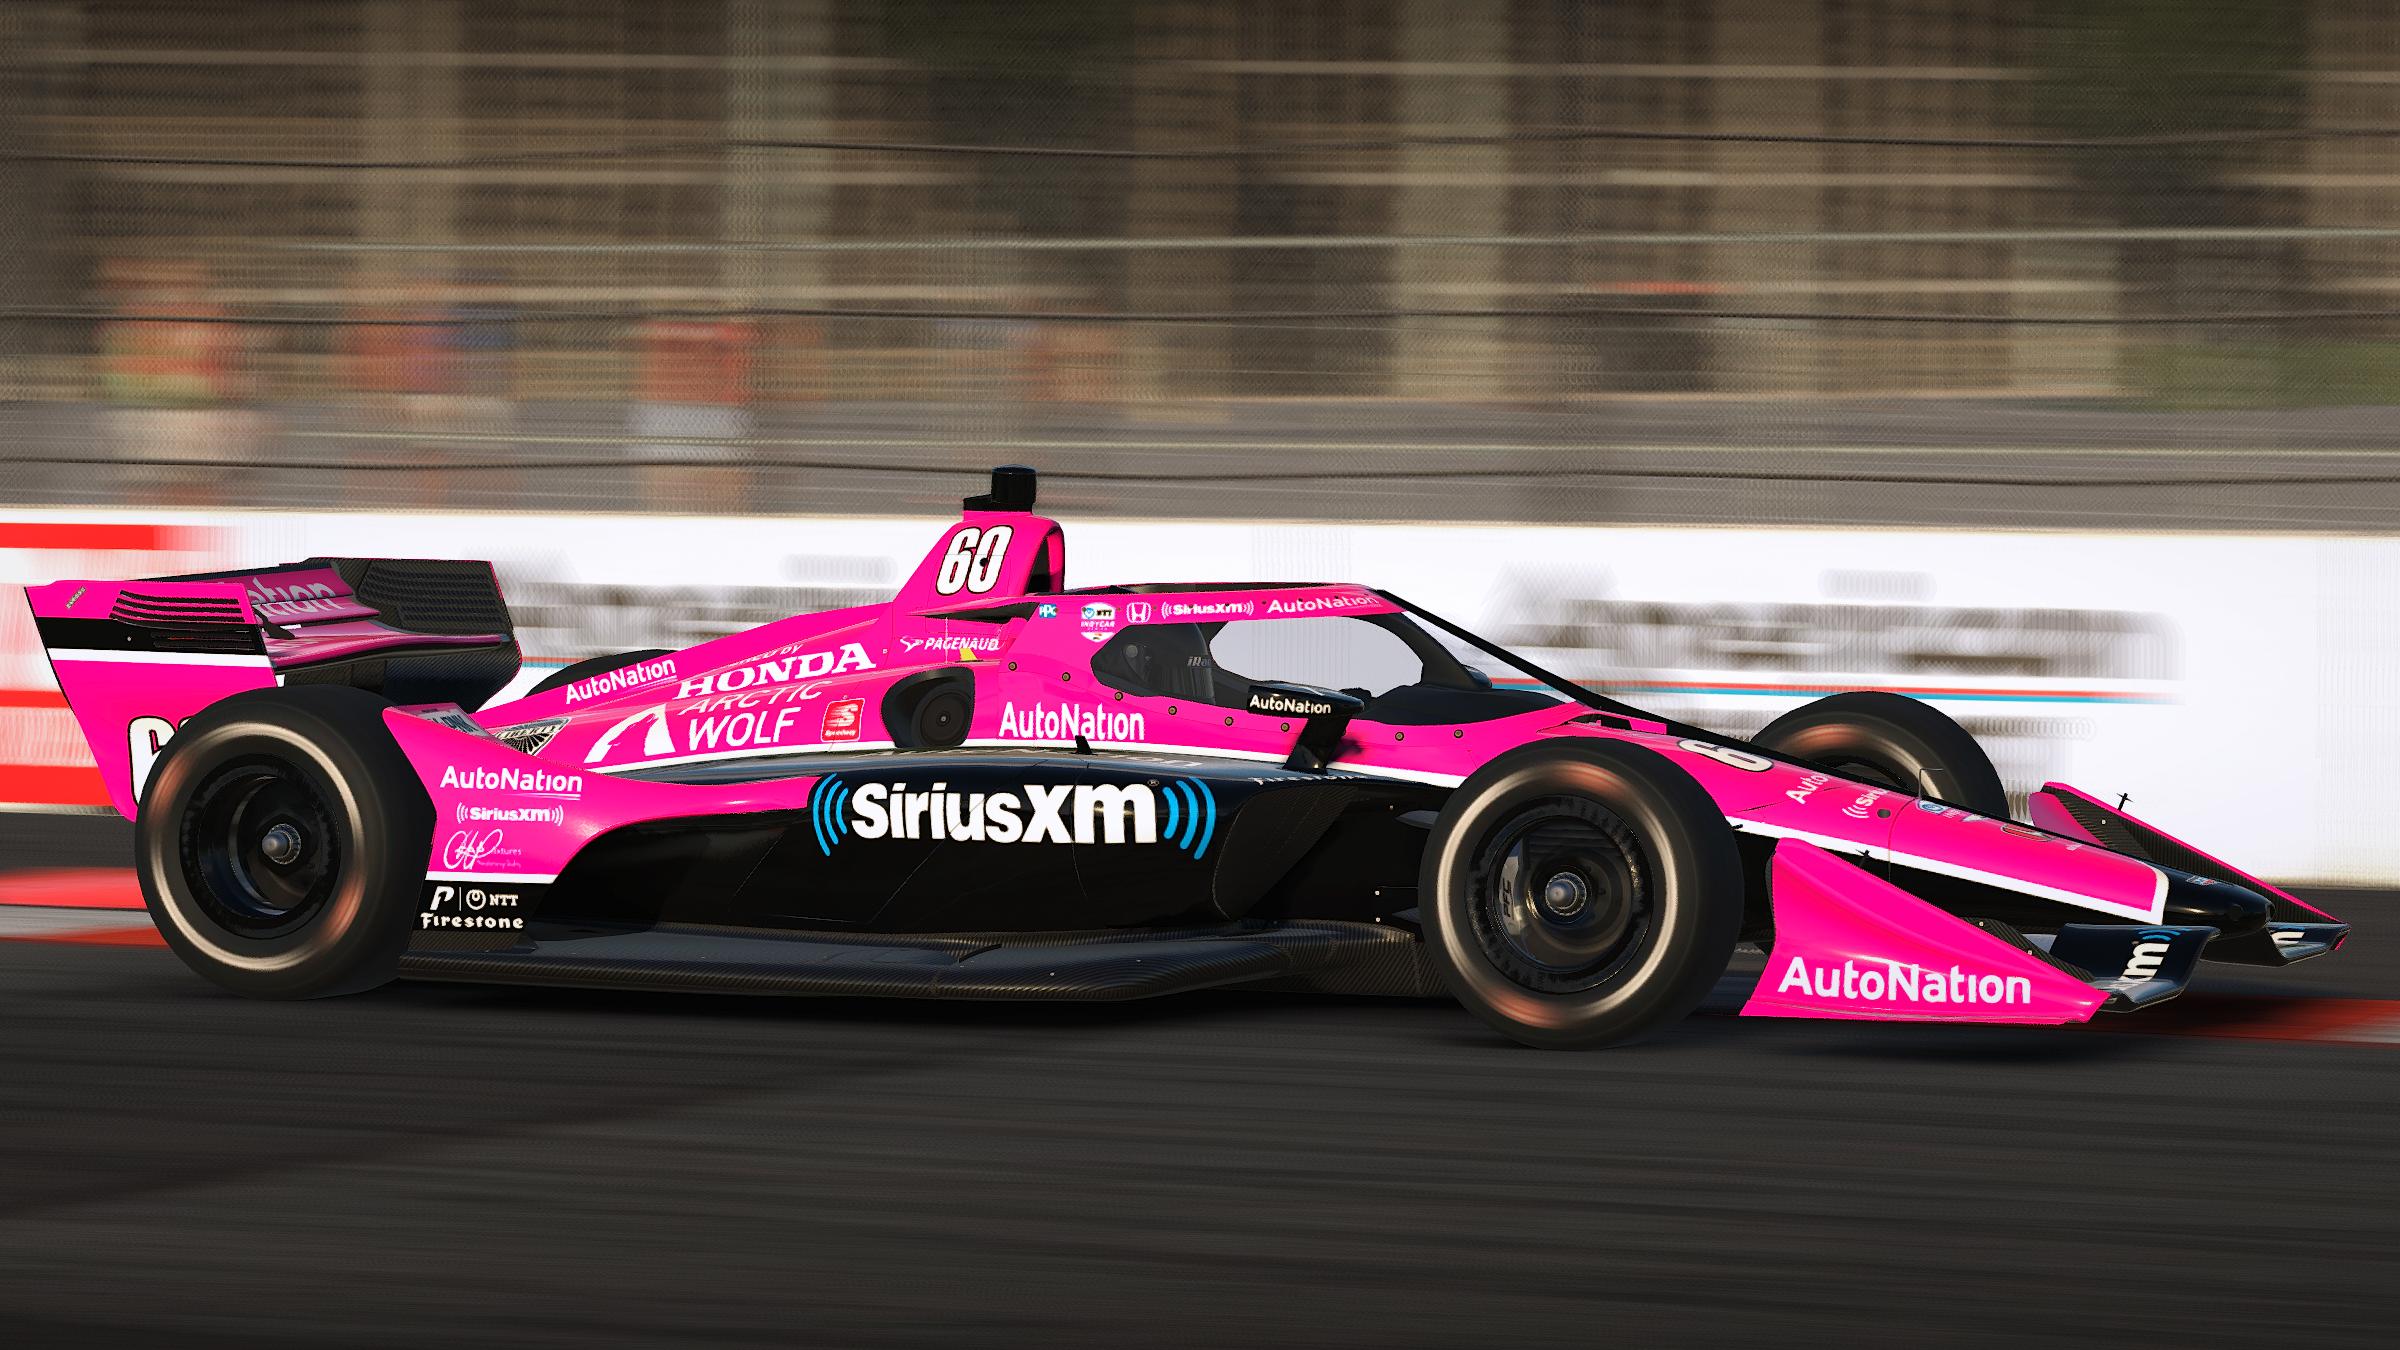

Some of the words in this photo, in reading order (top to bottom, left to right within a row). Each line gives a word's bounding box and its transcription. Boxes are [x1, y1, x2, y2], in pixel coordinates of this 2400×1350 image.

[936, 525, 1014, 596] 60
[1267, 595, 1379, 614] AutoNation
[924, 636, 1000, 650] PAGENAUD
[566, 658, 676, 704] AutoNation
[673, 642, 876, 700] HONDA
[677, 680, 832, 716] ARCTIC
[1249, 694, 1332, 714] AutoNation
[688, 706, 801, 752] WOLF
[999, 701, 1145, 741] AutoNation
[128, 716, 193, 807] 6
[440, 765, 583, 793] AutoNation
[1786, 772, 1831, 805] Auto
[489, 893, 518, 907] NTT
[421, 912, 524, 930] Firestone
[1778, 956, 2031, 1004] AutoNation
